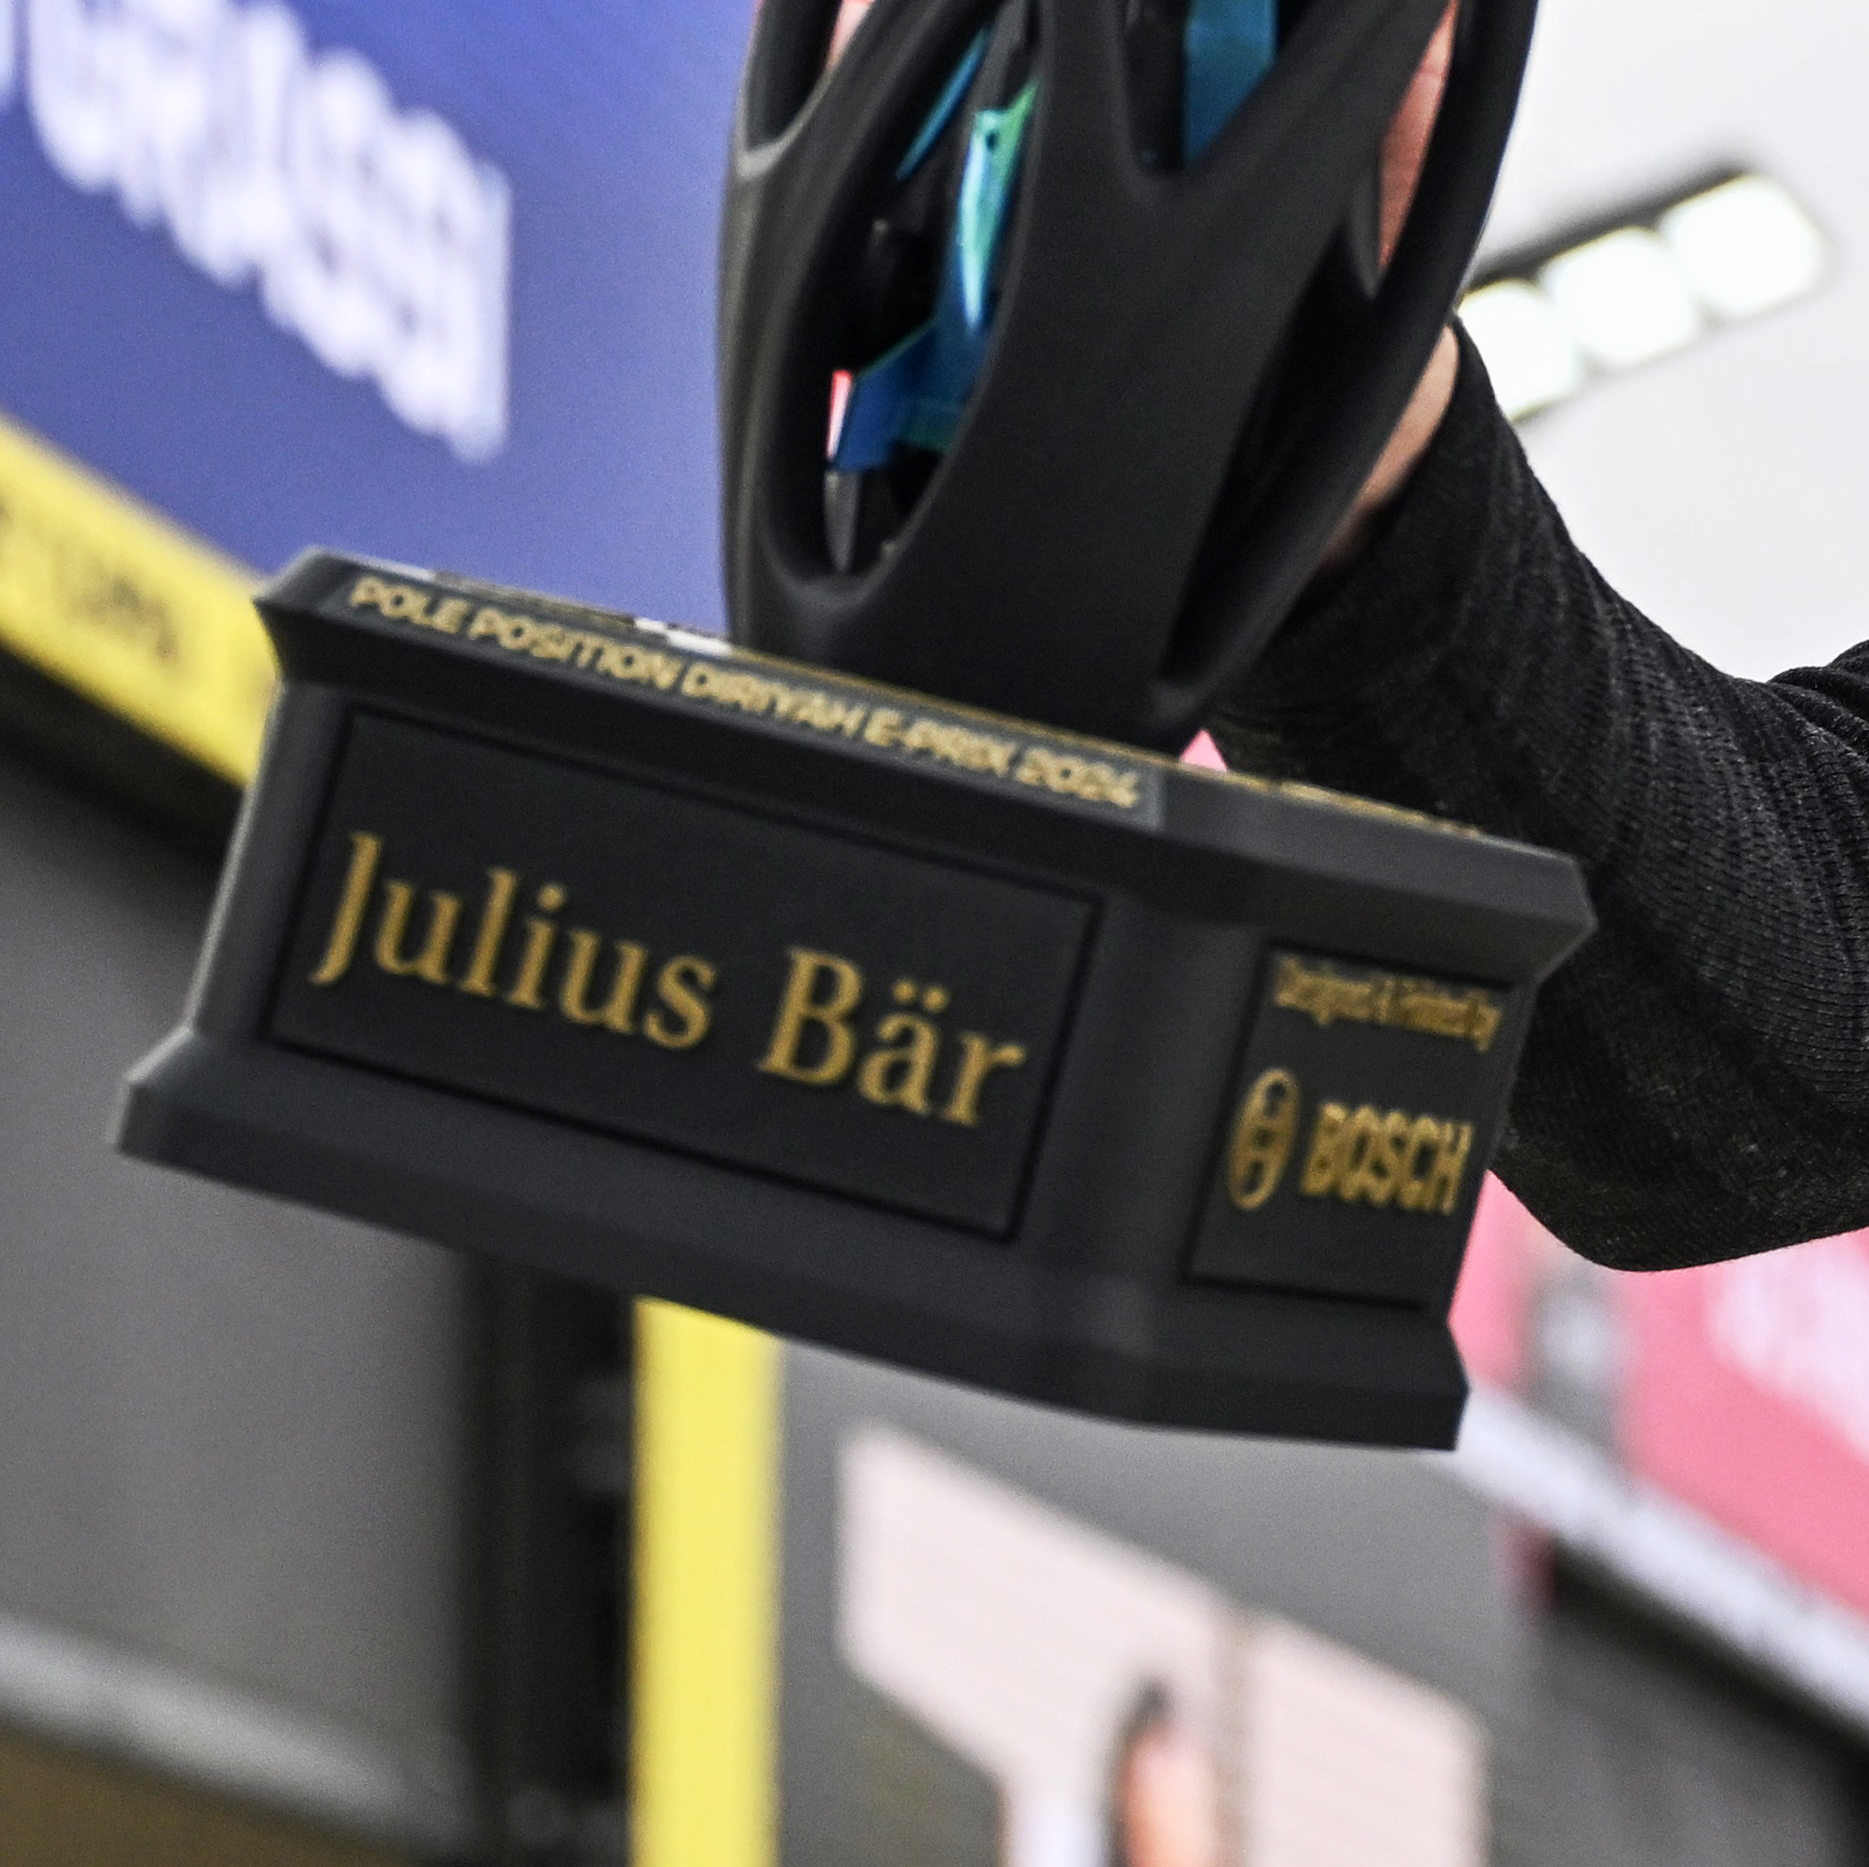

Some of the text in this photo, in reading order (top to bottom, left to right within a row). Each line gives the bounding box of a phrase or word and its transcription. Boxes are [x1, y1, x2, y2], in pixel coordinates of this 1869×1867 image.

[351, 576, 463, 635] POLE
[469, 606, 678, 690] POSITION
[683, 660, 867, 738] DIRIYAH
[309, 831, 1027, 1128] Julius Bär
[1300, 1101, 1474, 1216] BOSCH
